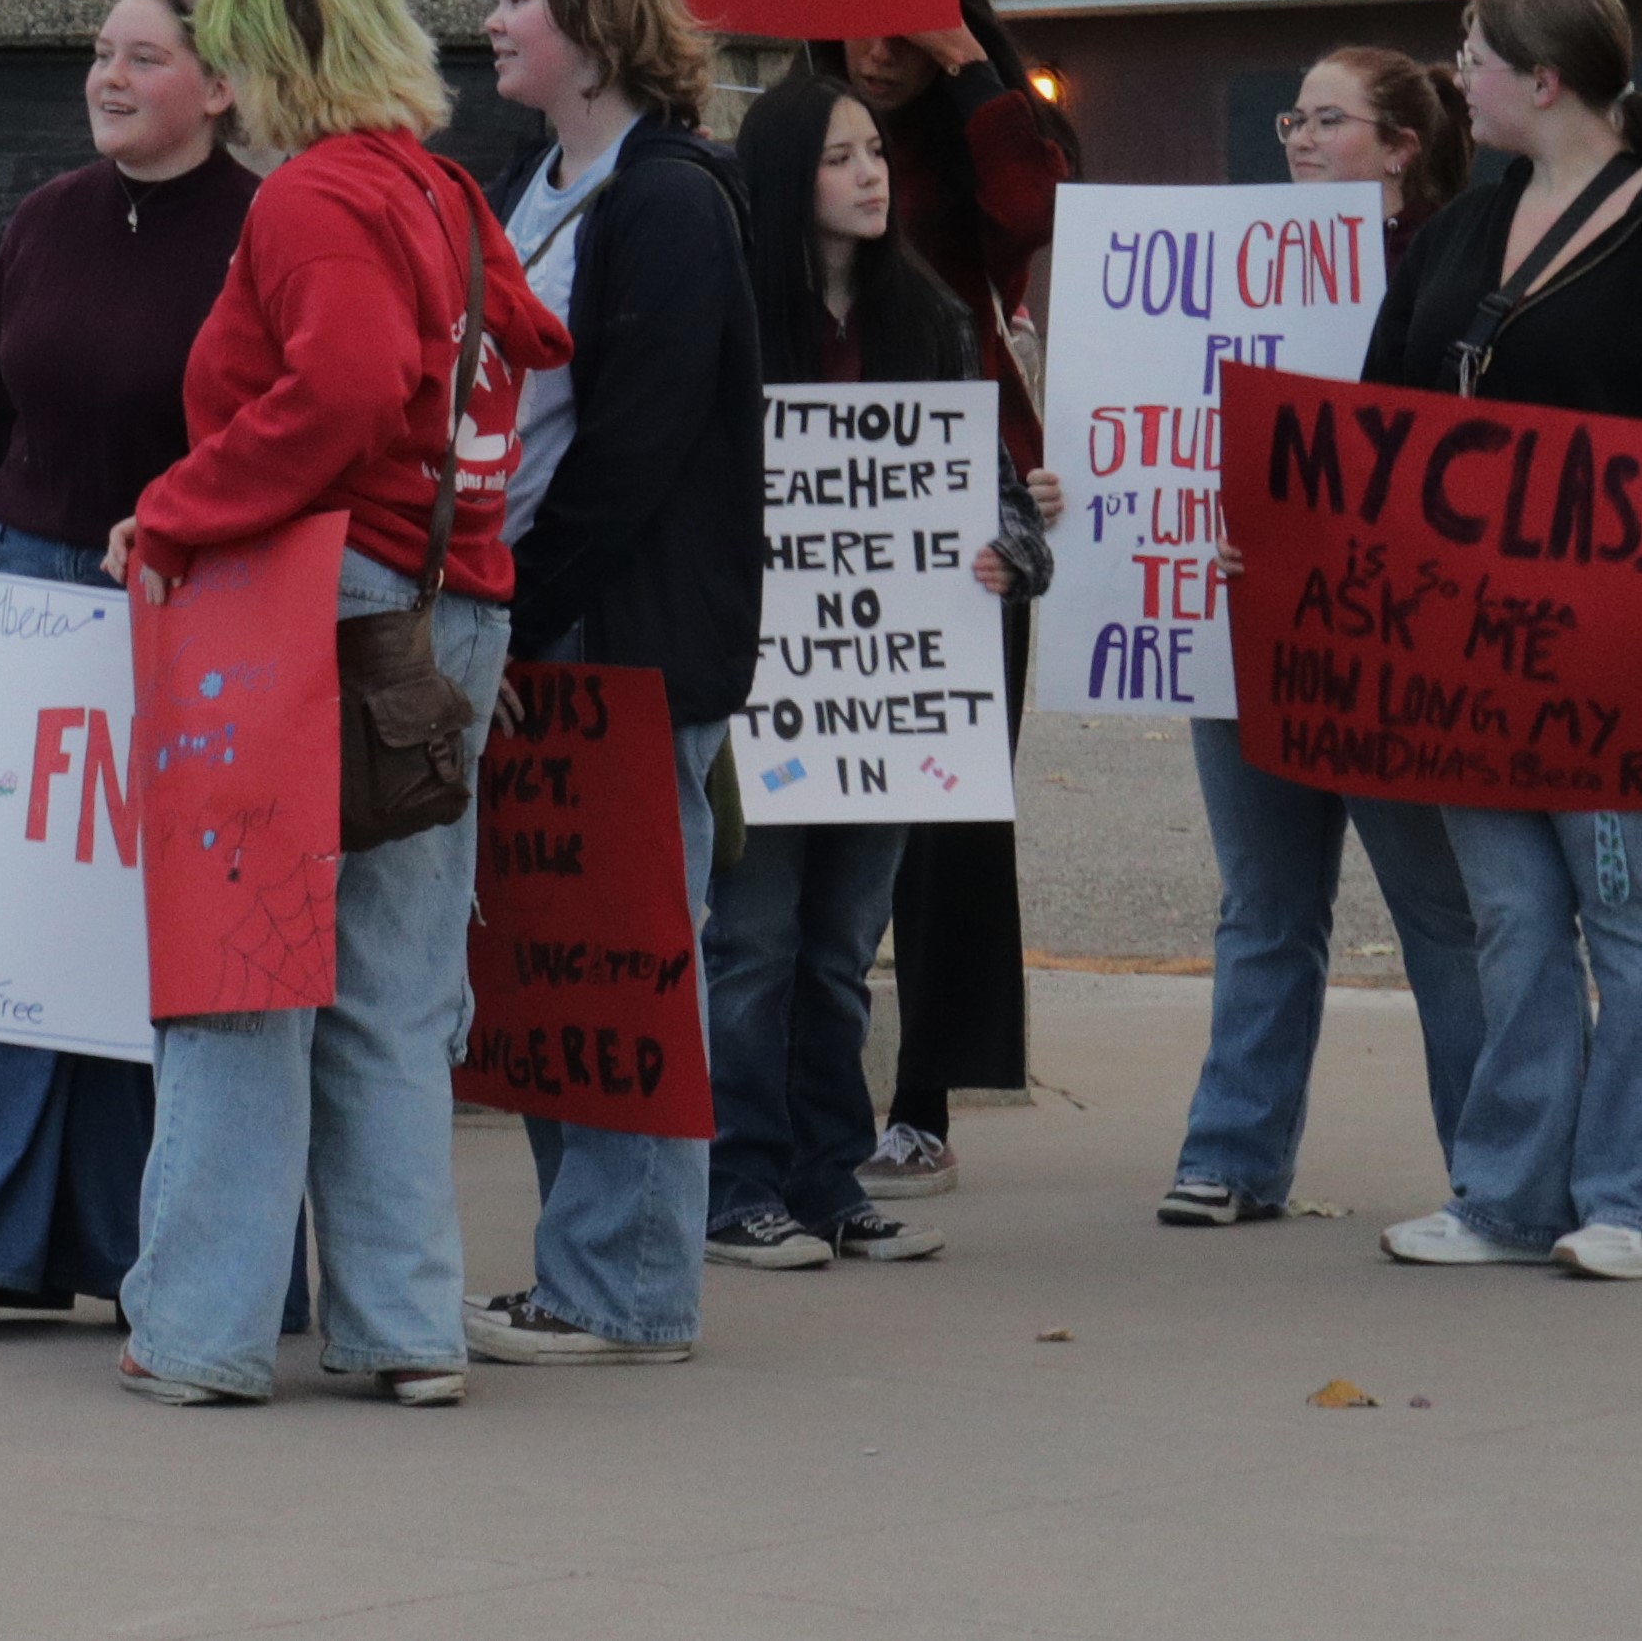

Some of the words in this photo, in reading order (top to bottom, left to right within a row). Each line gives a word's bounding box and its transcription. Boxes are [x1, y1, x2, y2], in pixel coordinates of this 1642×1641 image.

[1103, 229, 1214, 320] YOU
[1236, 213, 1365, 308] CAN'T
[763, 396, 965, 447] ITHOUT
[1268, 400, 1417, 525] MY
[1421, 418, 1642, 565] CLAS
[913, 530, 960, 573] IS
[817, 587, 881, 629] NO
[1294, 565, 1413, 650] ASK
[1463, 609, 1559, 685] ME
[1088, 622, 1195, 703] ARE
[733, 698, 804, 740] TO
[814, 689, 994, 735] INVEST
[1272, 641, 1362, 715] HOW
[1527, 698, 1621, 757] MY
[836, 756, 888, 796] IN
